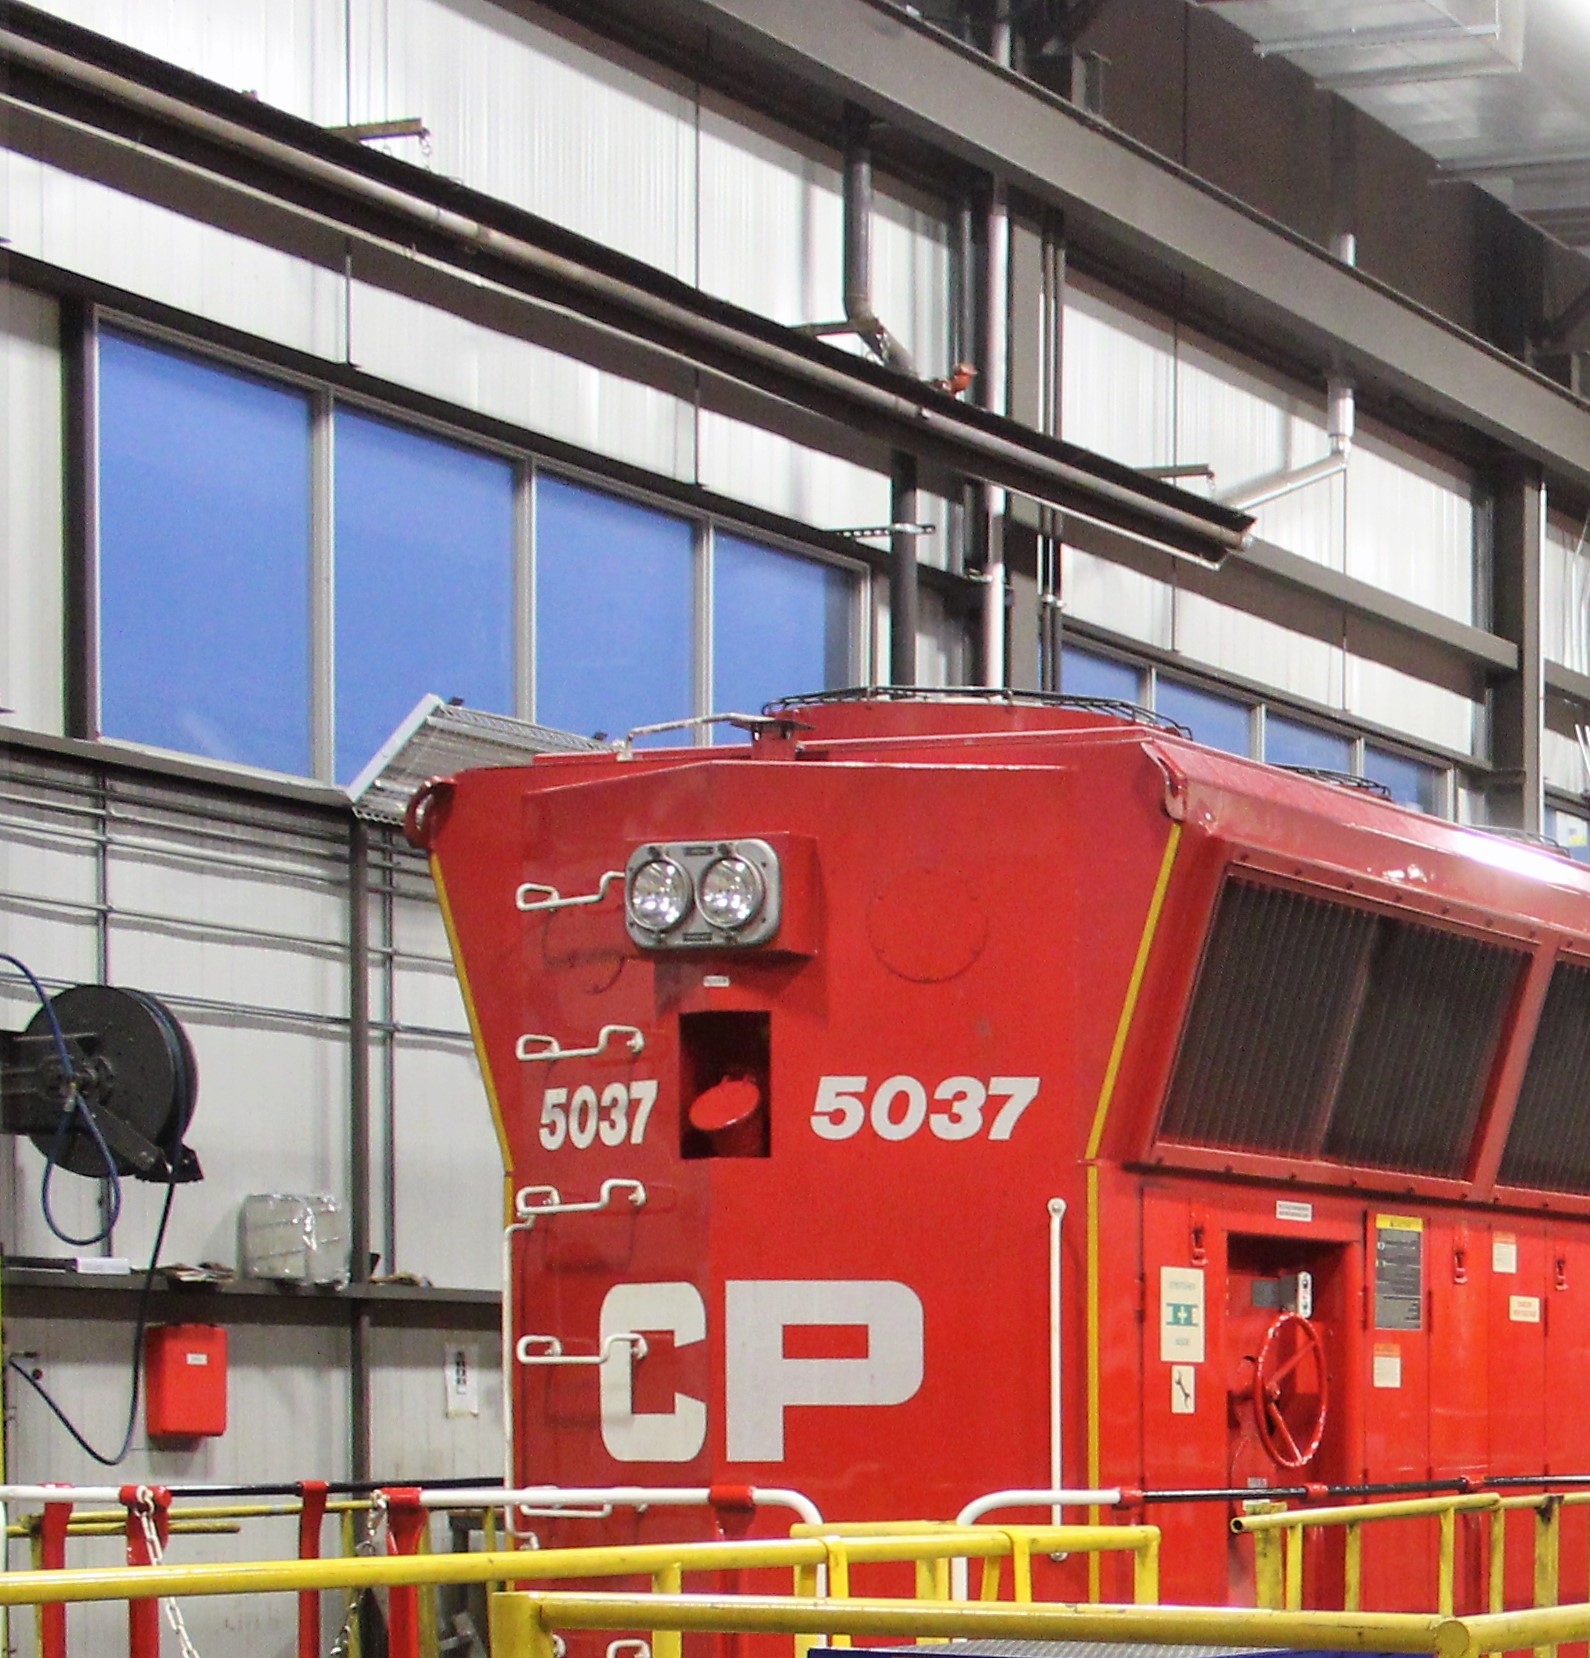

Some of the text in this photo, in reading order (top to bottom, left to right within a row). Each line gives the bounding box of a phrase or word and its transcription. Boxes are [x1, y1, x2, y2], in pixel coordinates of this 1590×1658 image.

[539, 1080, 658, 1150] 5037
[810, 1075, 1040, 1142] 5037
[600, 1281, 924, 1462] CP
